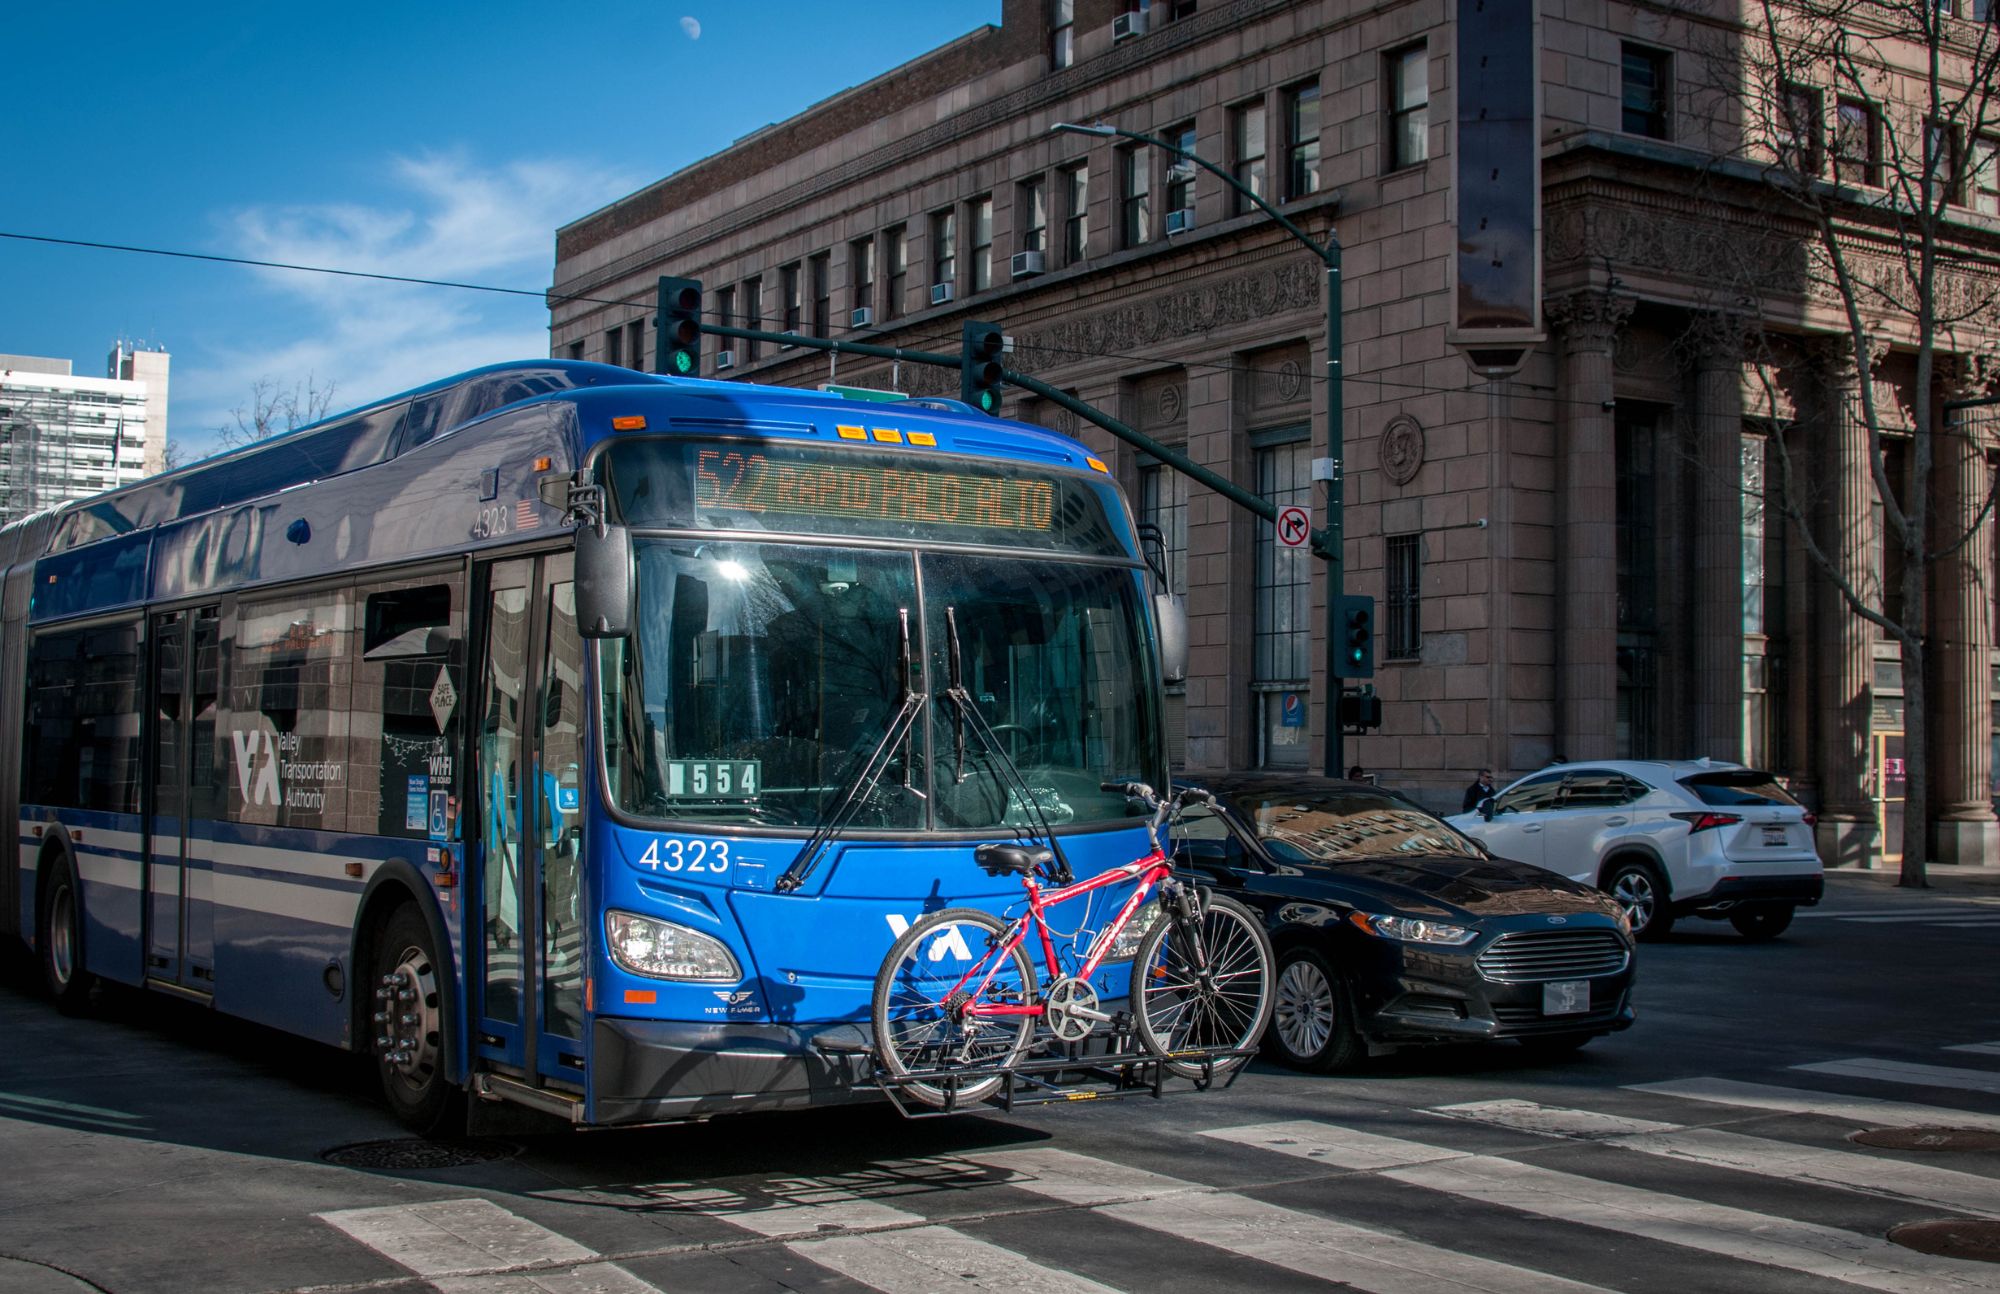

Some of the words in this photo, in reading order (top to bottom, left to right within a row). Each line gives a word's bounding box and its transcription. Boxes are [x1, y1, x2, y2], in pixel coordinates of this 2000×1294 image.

[698, 450, 769, 512] 522
[778, 467, 871, 509] RAPID
[880, 469, 960, 521] PALO
[976, 479, 1052, 530] ALTO
[474, 505, 508, 538] 4323
[434, 695, 453, 708] PLACE
[437, 683, 450, 695] SAFE
[278, 731, 301, 756] Valley
[280, 759, 342, 783] Transportation
[693, 764, 756, 794] 554
[285, 787, 326, 815] Authority
[639, 838, 729, 873] 4323
